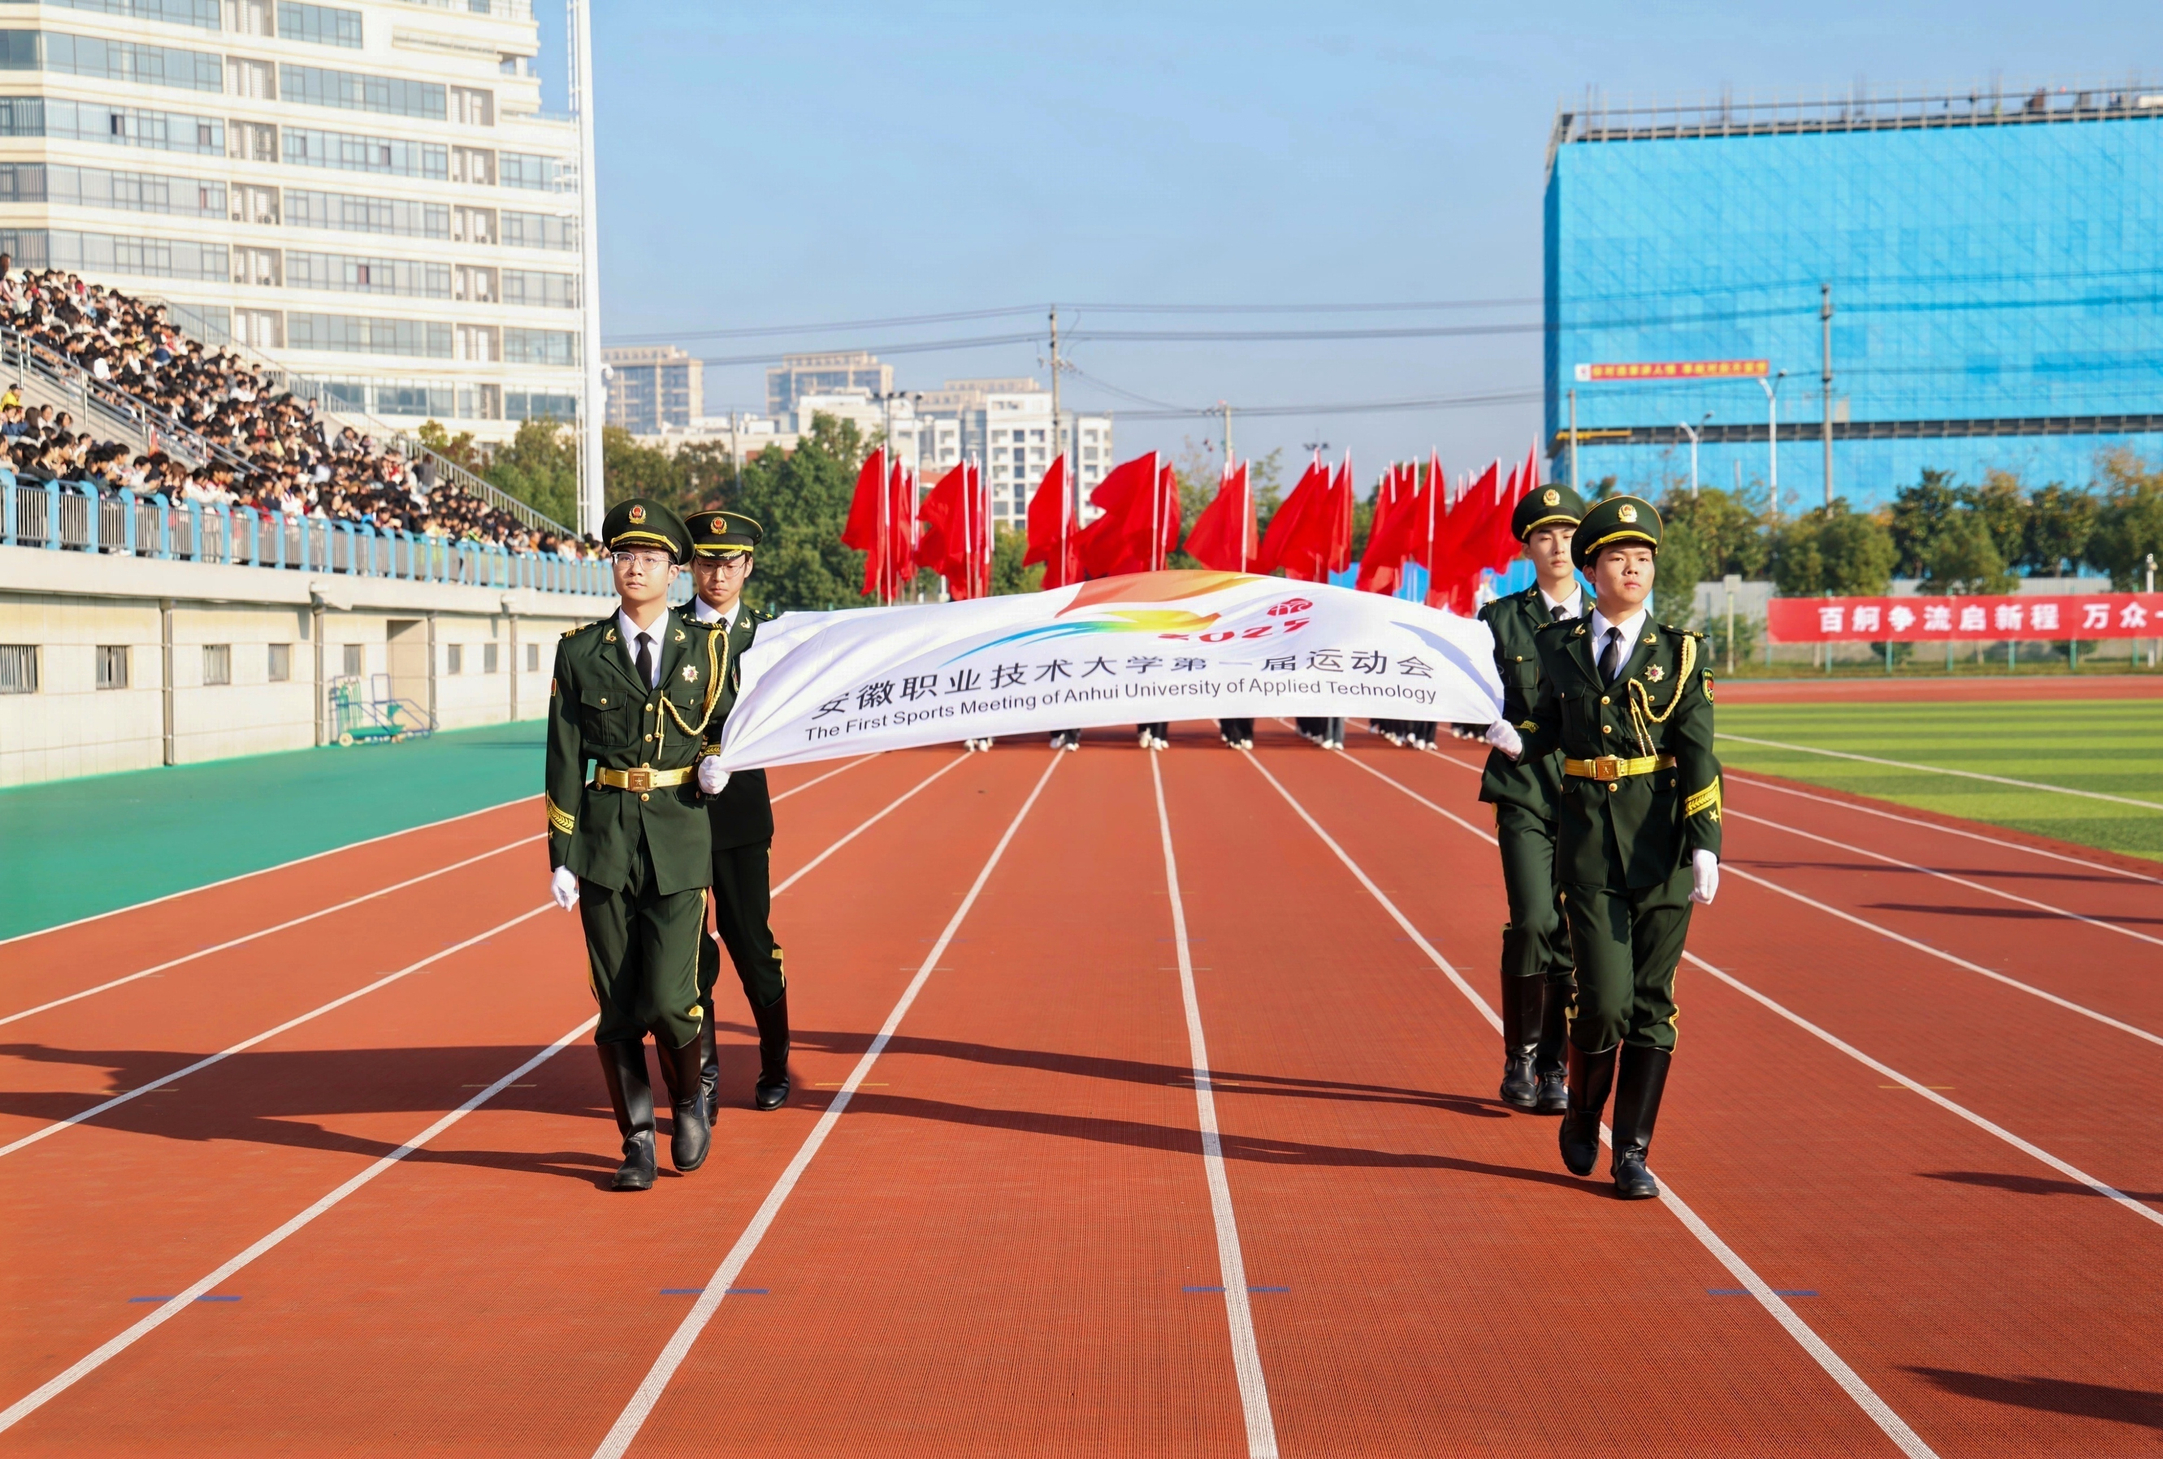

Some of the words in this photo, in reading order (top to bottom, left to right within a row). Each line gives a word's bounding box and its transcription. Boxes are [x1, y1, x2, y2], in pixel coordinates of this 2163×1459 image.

[1817, 604, 2060, 633] 百舸争流启新程
[805, 726, 840, 741] The
[846, 714, 888, 733] First
[892, 705, 955, 725] Sports
[960, 694, 1036, 715] Meeting
[1042, 689, 1062, 705] of
[1063, 683, 1119, 702] Anhui
[1125, 680, 1221, 697] University
[1226, 678, 1246, 693] of
[1249, 678, 1321, 696] Applied
[1326, 681, 1437, 704] Technology
[811, 649, 1435, 720] 安徽职业技术大学第一届运动会
